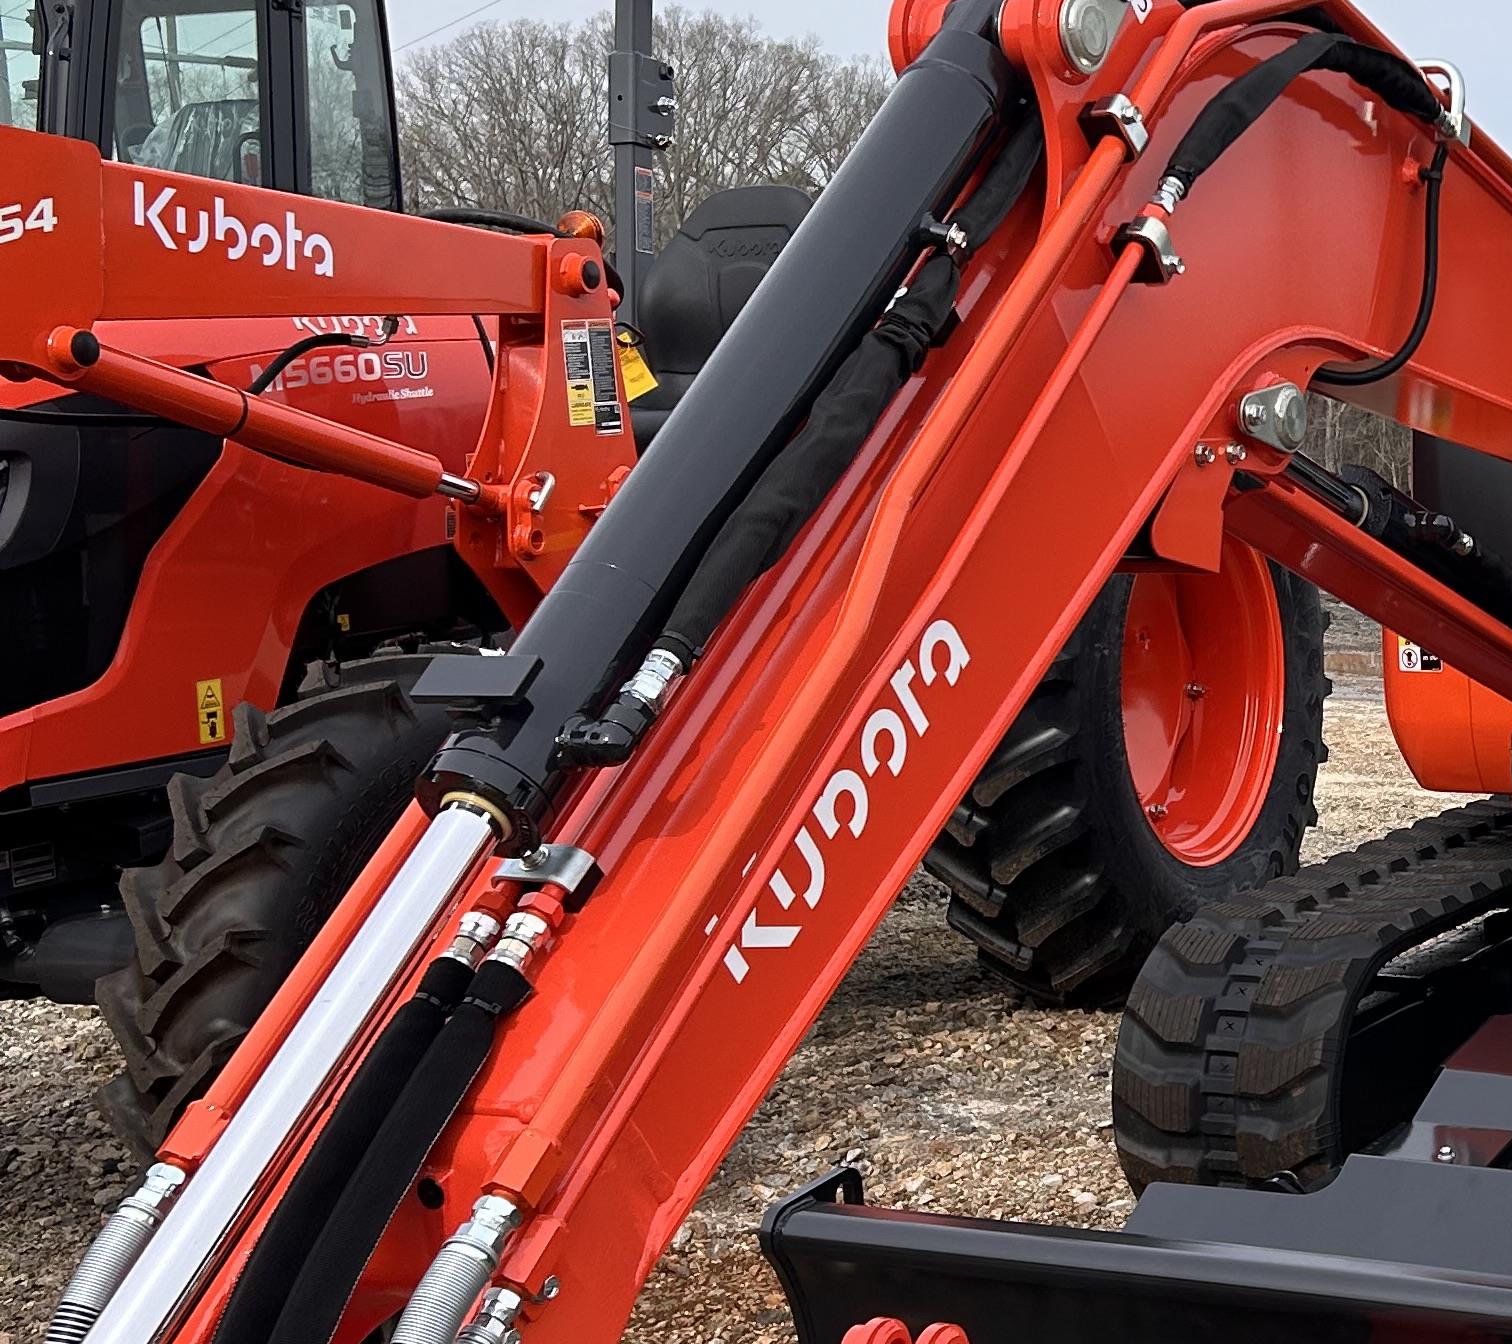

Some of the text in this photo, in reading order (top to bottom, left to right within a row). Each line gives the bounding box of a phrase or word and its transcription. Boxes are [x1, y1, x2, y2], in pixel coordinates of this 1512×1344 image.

[134, 181, 334, 277] Kubota
[400, 386, 433, 400] Shuttle
[707, 619, 971, 984] Kubota
